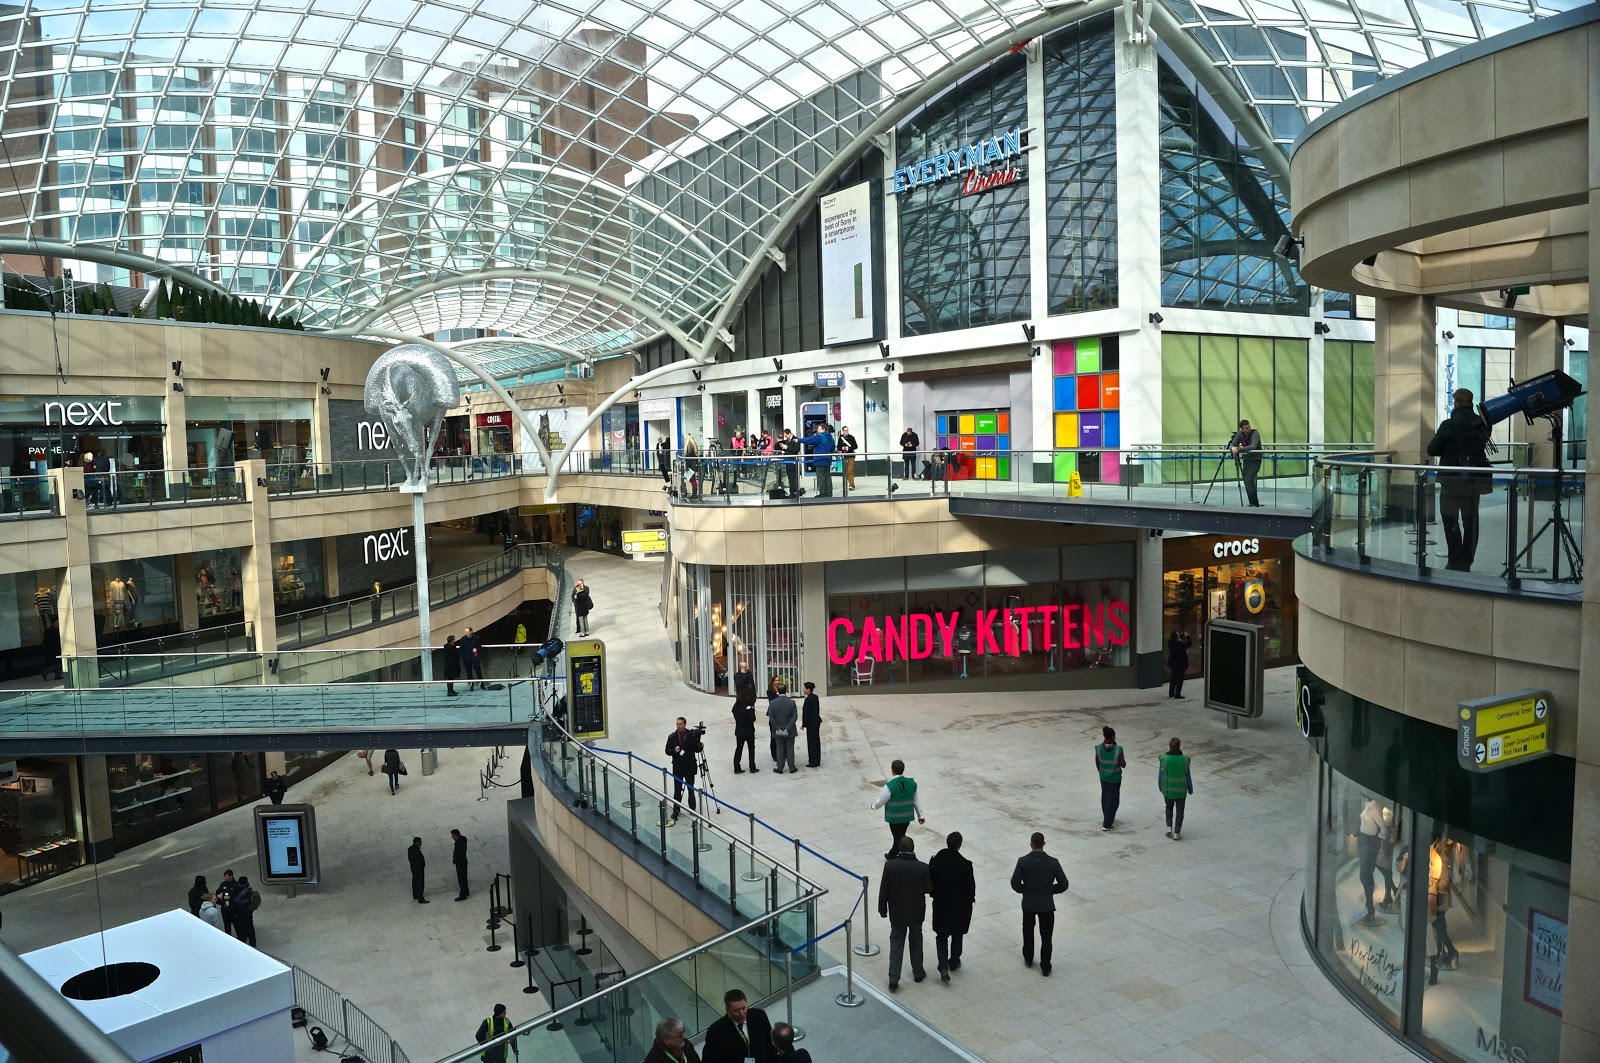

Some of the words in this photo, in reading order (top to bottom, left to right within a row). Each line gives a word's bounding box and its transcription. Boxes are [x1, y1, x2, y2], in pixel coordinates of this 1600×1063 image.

[893, 127, 1021, 193] EVERYMAN
[963, 166, 1017, 195] Cinema
[824, 211, 848, 223] experience
[849, 208, 857, 216] the
[824, 223, 834, 231] best
[835, 220, 840, 228] of
[840, 218, 852, 227] Sony
[828, 225, 856, 236] smartphone
[44, 400, 123, 426] next
[357, 421, 397, 450] nex
[28, 446, 46, 455] PAY
[50, 446, 75, 454] HE
[363, 528, 409, 564] next
[1213, 538, 1260, 558] crocs
[828, 611, 960, 665] CANDY
[976, 600, 1130, 655] KITTENS
[1496, 709, 1520, 720] Commercial
[1520, 707, 1532, 715] Street
[1462, 725, 1470, 756] Ground
[1503, 740, 1515, 748] Lower
[1515, 736, 1530, 745] Ground
[1503, 748, 1512, 756] First
[1537, 926, 1566, 949] 75%
[1536, 941, 1566, 963] OFF
